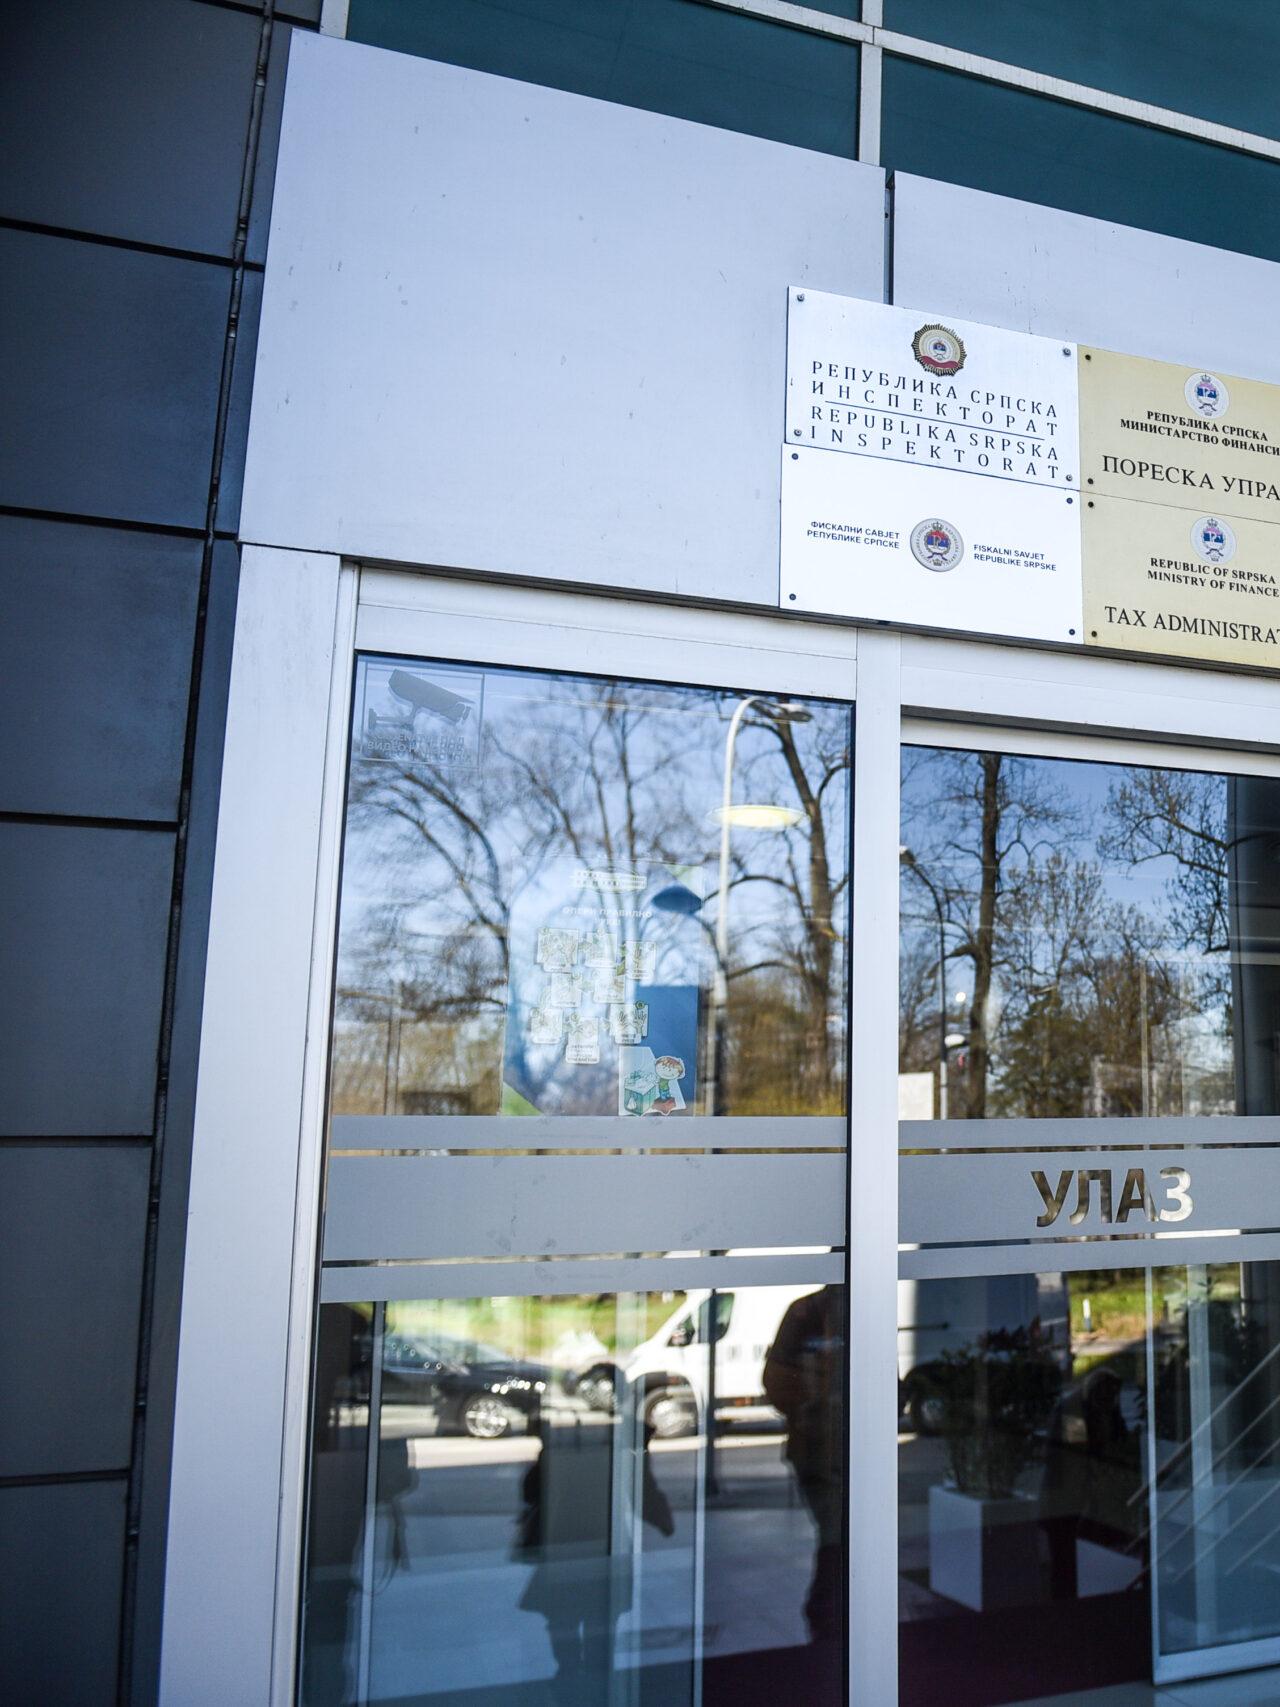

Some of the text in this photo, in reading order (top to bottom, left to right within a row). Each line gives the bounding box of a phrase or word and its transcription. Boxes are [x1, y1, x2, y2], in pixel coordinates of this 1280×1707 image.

[811, 360, 1057, 418] РЕПУБЛИКА СРПСКА
[811, 381, 1057, 437] ИНСПЕКТОРАТ
[811, 406, 1058, 460] REPUBLIKA SRPSKA
[1120, 418, 1219, 445] МИНИСТАРСТВО
[1147, 410, 1268, 442] РЕПУБЛИКА СРПСКА
[811, 427, 1058, 479] INSPEKTORAT
[1101, 454, 1215, 490] ПОРЕСКА
[807, 530, 900, 549] РЕПУБЛИКЕ СРПСКЕ
[810, 520, 900, 540] ФИСКАЛНИ САВЈЕТ
[973, 544, 1045, 560] FISKALNI SAVJET
[973, 553, 1057, 571] REPUBLIKE SRPSKE
[1147, 570, 1280, 597] MINISTRY OF FINANCE
[1150, 557, 1276, 584] REPUBLIC OF SRPSKA
[1104, 606, 1147, 627] TAX
[1030, 1166, 1193, 1227] УЛАЗ
